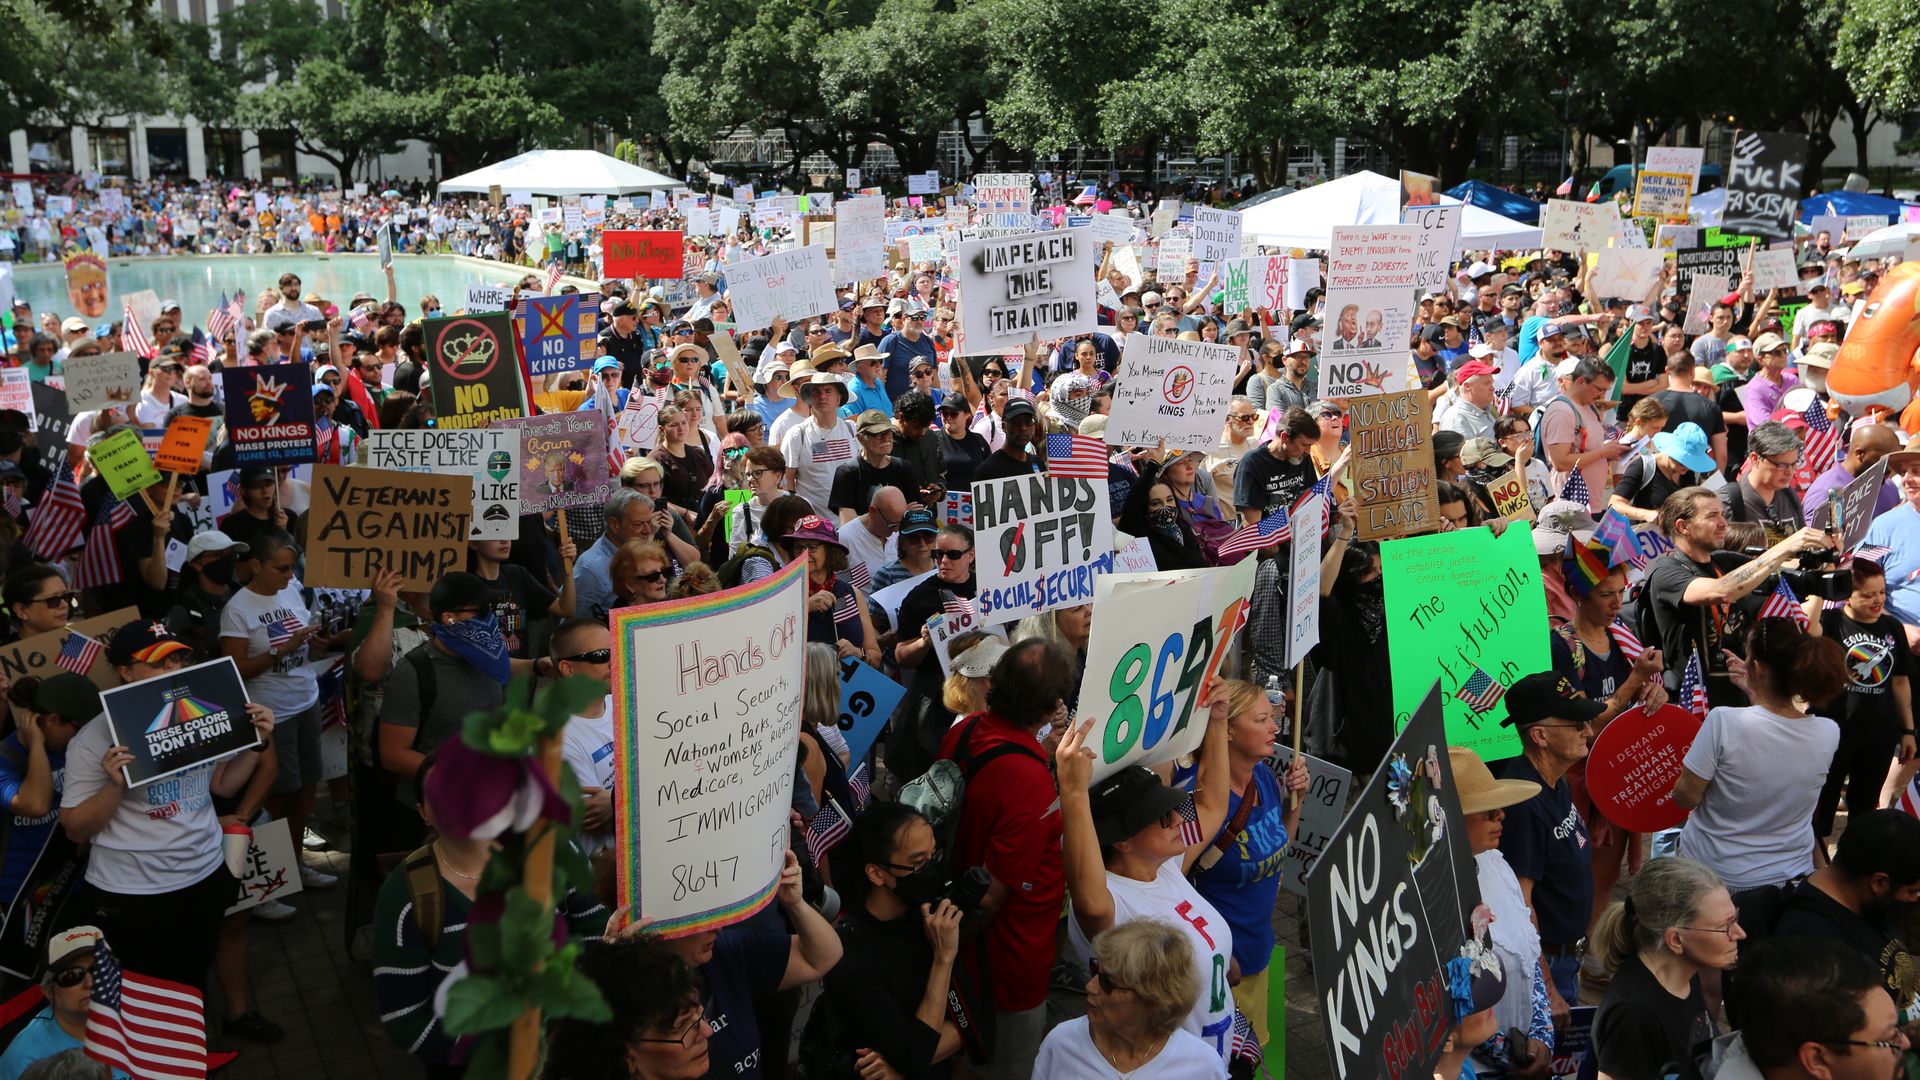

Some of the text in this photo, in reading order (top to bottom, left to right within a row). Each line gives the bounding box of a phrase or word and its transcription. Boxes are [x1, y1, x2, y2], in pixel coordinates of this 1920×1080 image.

[978, 174, 1030, 186] THIS IS THE
[978, 187, 1030, 202] GOVERNMENT
[1195, 207, 1240, 229] Grow up
[1724, 190, 1797, 226] FASCISM
[995, 213, 1030, 228] FOUNDERS
[1416, 209, 1448, 229] ICE
[1196, 226, 1235, 243] Donnie
[1418, 234, 1428, 247] IS
[610, 241, 635, 261] No
[985, 235, 1074, 270] IMPEACH
[727, 251, 815, 286] Ice Will Melt
[1333, 260, 1353, 271] There
[1371, 261, 1409, 271] DOMESTIC
[767, 275, 787, 289] But
[1009, 269, 1049, 298] THE
[1332, 275, 1363, 286] THREATS
[469, 289, 504, 306] WHERE
[994, 301, 1078, 332] TRAITOR
[542, 338, 565, 356] NO
[531, 355, 576, 374] KINGS
[1127, 361, 1140, 378] You
[1329, 362, 1364, 385] NO
[1198, 372, 1208, 385] I
[453, 383, 489, 415] NO
[1117, 387, 1132, 398] Free
[1327, 384, 1363, 396] KINGS
[1158, 405, 1185, 417] KINGS
[1193, 394, 1204, 408] You
[1205, 397, 1216, 407] Are
[177, 426, 199, 434] UNITE
[236, 424, 309, 441] NO KINGS
[565, 415, 595, 432] Your
[235, 438, 313, 452] MASS PROTEST
[372, 431, 504, 450] ICE DOESN'T
[528, 438, 573, 454] Crown
[1121, 429, 1136, 443] NO
[1358, 423, 1424, 456] ILLEGAL
[97, 440, 137, 462] OVERTURN
[236, 451, 265, 462] JUNE
[284, 448, 313, 458] 2025
[372, 449, 479, 467] TASTE LIKE
[113, 457, 139, 472] TRANS
[1378, 456, 1404, 478] ON
[126, 473, 143, 484] BAN
[1362, 468, 1430, 501] STOLEN
[323, 476, 450, 508] VETERANS
[481, 482, 518, 501] LIKE
[1492, 480, 1521, 506] NO
[520, 499, 548, 514] King
[973, 477, 1096, 531] HANDS
[1498, 494, 1530, 518] KINGS
[317, 510, 474, 543] AGAINST
[1369, 501, 1426, 532] LAND
[1000, 513, 1095, 574] OFF!
[1391, 547, 1423, 560] We the
[327, 547, 458, 584] TRUMP
[1122, 555, 1152, 572] YOUR
[1406, 555, 1478, 573] establish justice
[1416, 569, 1481, 584] ensure domestic
[259, 612, 273, 625] NO
[1409, 595, 1446, 631] The
[948, 613, 973, 635] NO
[0, 647, 47, 680] No
[674, 611, 797, 698] Hands Off
[1102, 597, 1247, 765] 8647
[1602, 676, 1615, 696] NO
[145, 711, 229, 744] THESE COLORS
[653, 701, 719, 740] Social
[149, 720, 233, 757] DON'T RUN
[664, 717, 773, 768] National Parks,
[706, 720, 793, 774] WOMENS RIGHTS
[1609, 724, 1665, 769] I DEMAND
[1624, 743, 1674, 783] HUMANE
[1632, 745, 1653, 764] THE
[1612, 753, 1678, 805] TREATMENT
[657, 773, 744, 807] Medicare,
[666, 765, 792, 844] IMMIGRANTS
[671, 856, 740, 902] 8647
[1329, 812, 1382, 951] NO
[1326, 881, 1418, 1080] KINGS
[948, 990, 968, 1028] EOS 70D
